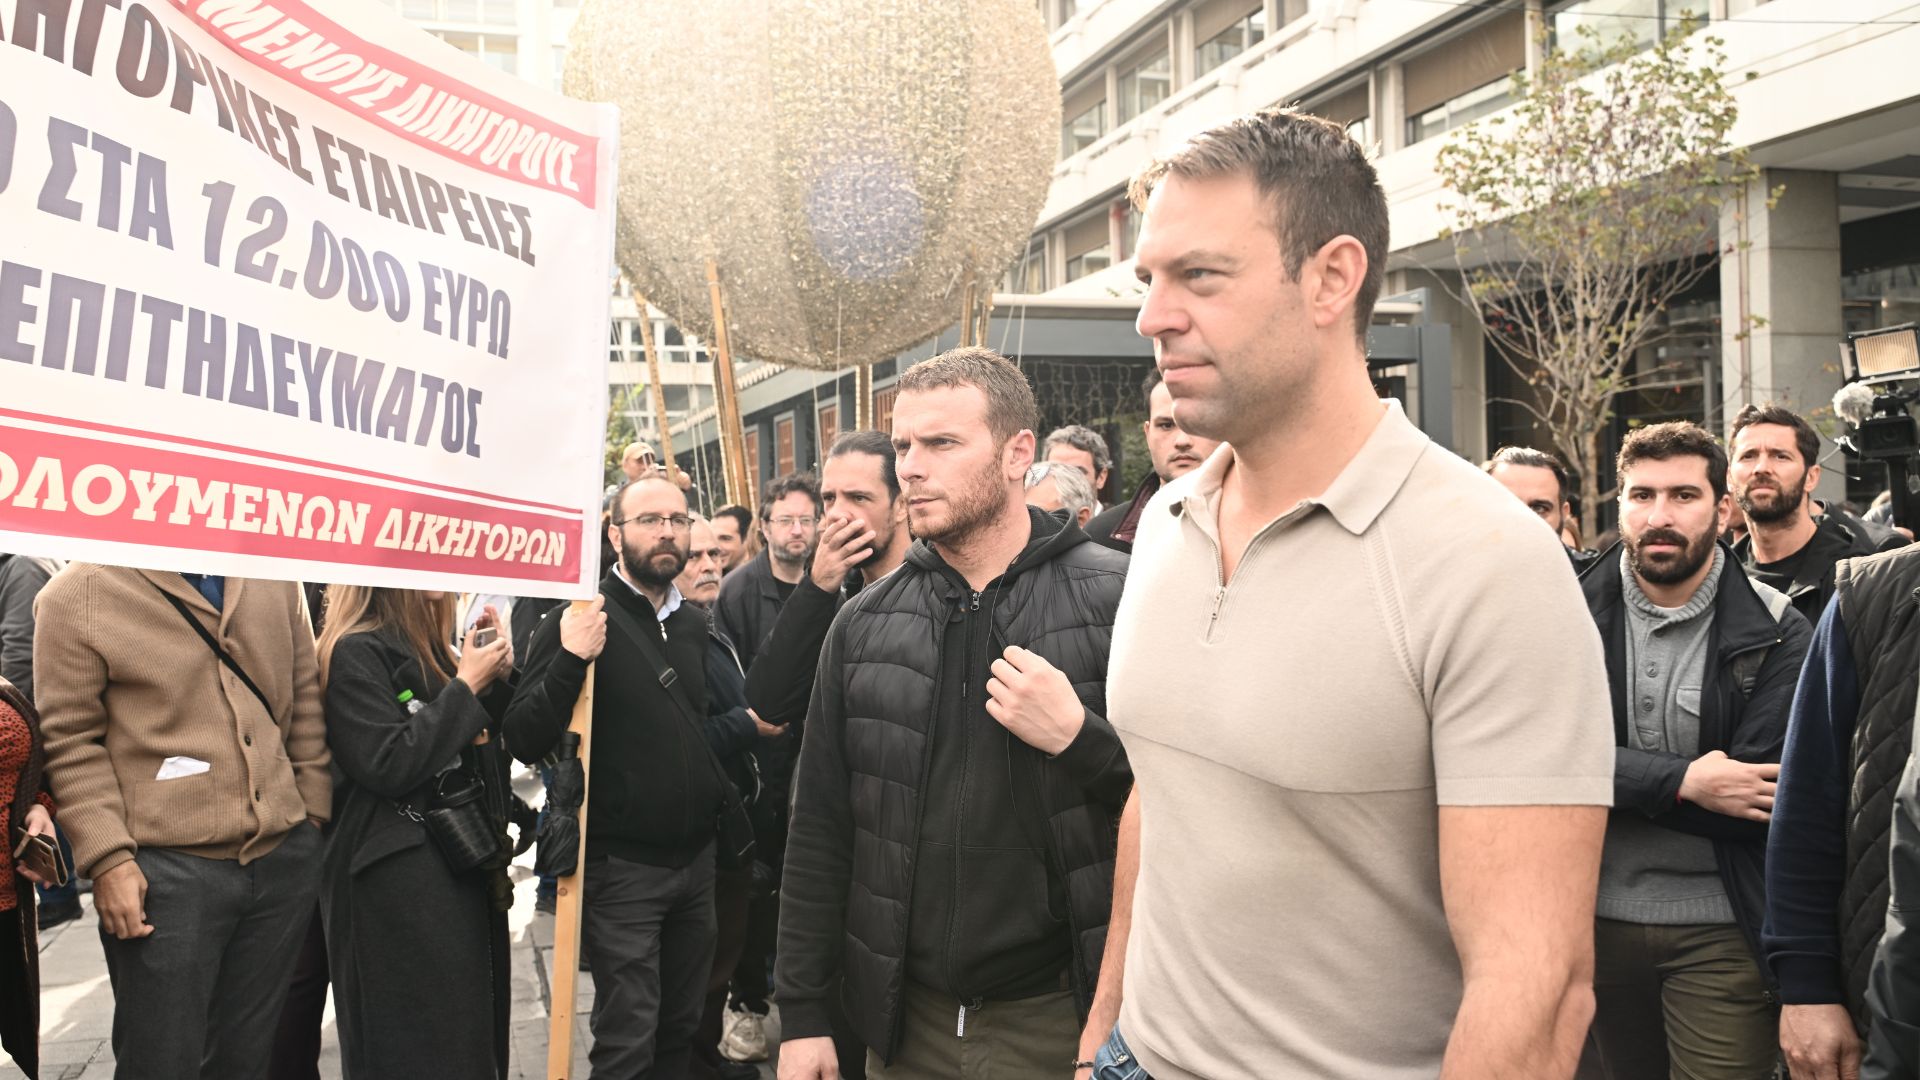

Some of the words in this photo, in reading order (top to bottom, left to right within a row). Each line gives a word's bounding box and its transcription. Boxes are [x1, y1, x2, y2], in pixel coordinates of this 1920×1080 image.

[0, 0, 314, 185] ΗΓΟΡΙΚΕΣ
[312, 126, 536, 267] ΕΤΑΙΡΕΙΕΣ
[177, 0, 407, 109] ΜΕΝΟΥΣ
[380, 83, 580, 192] ΔΙΚΗΓΟΡΟΥΣ
[37, 116, 174, 250] ΣΤΑ
[202, 181, 410, 322] 12.000
[419, 262, 511, 360] ΕΥΡΩ
[0, 260, 482, 459] ΕΠΙΤΗΔΕΥΜΑΤΟΣ
[374, 507, 566, 567] ΔΙΚΗΓΟΡΩΝ
